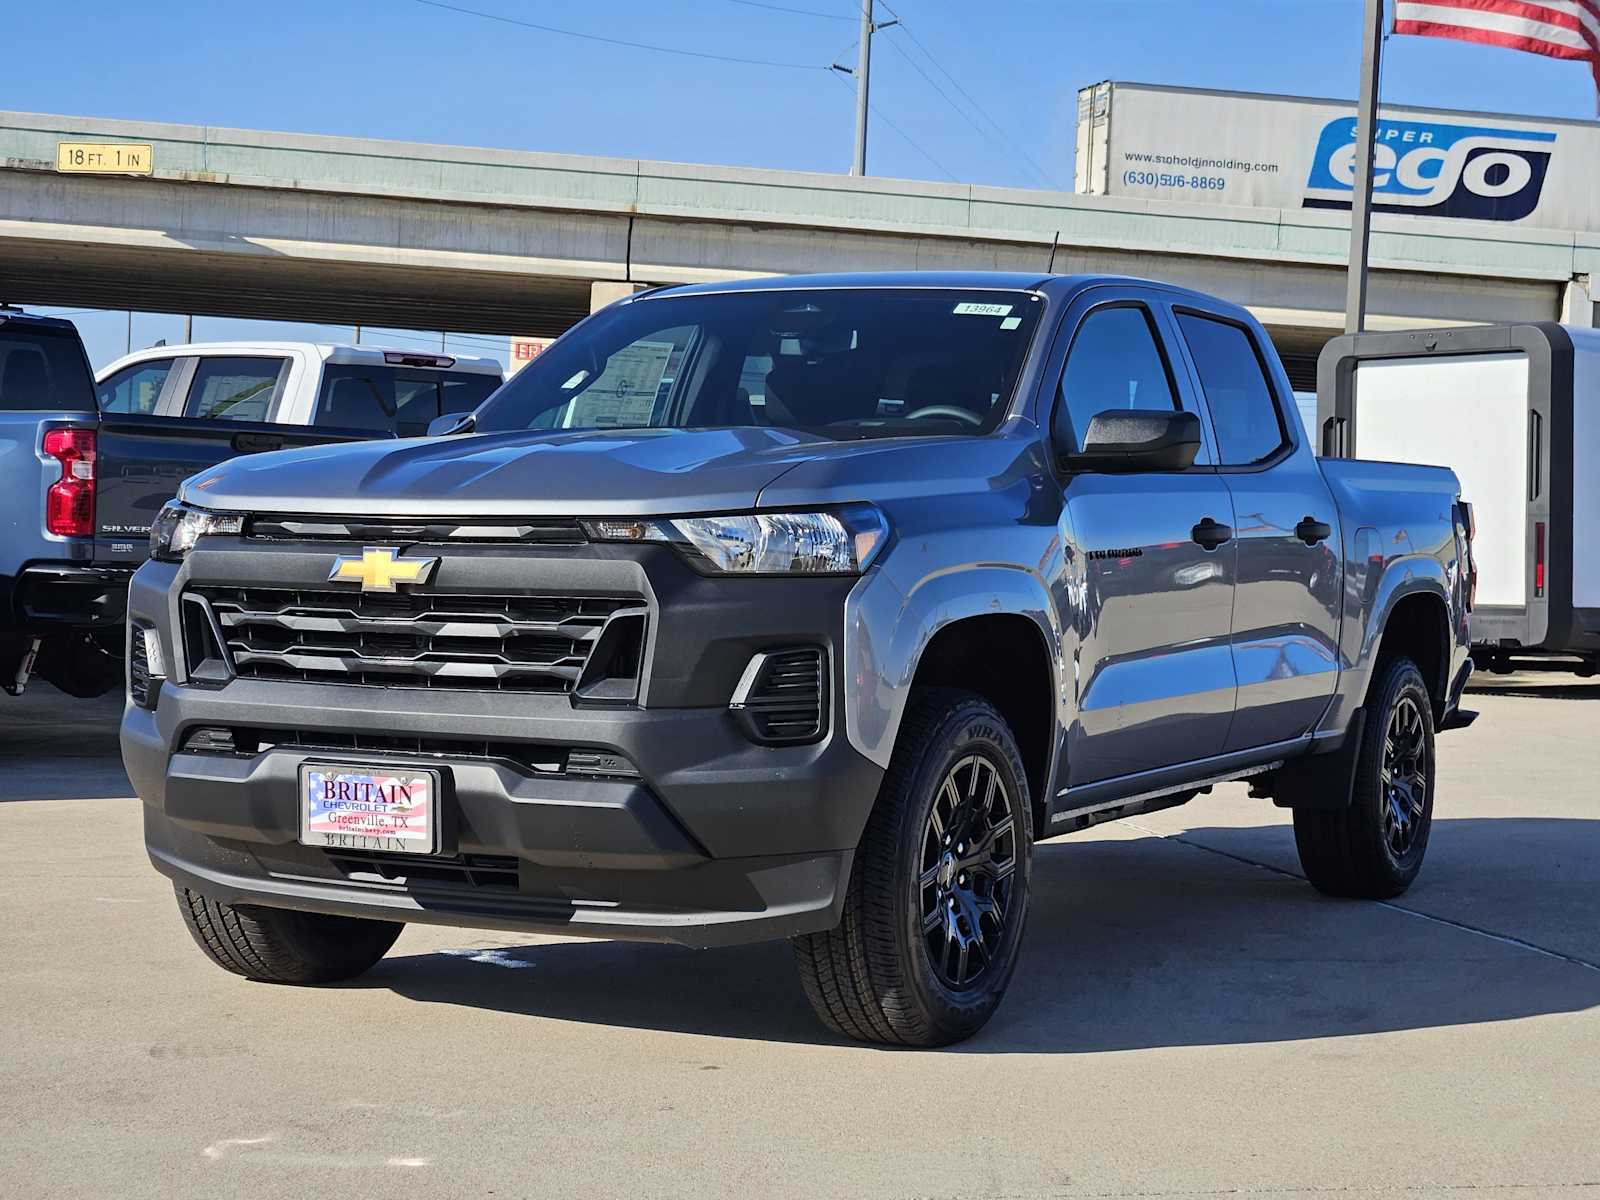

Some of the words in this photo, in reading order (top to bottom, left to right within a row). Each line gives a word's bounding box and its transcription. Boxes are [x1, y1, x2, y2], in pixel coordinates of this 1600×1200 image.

[1350, 126, 1434, 144] SPER
[69, 149, 84, 165] 18
[127, 154, 140, 167] IN
[964, 305, 1002, 313] 13964
[324, 781, 413, 806] BRITAIN
[323, 800, 388, 813] CHEVROLET
[328, 812, 388, 828] Greenville,
[392, 815, 409, 829] TX
[325, 833, 407, 850] BRITAIN
